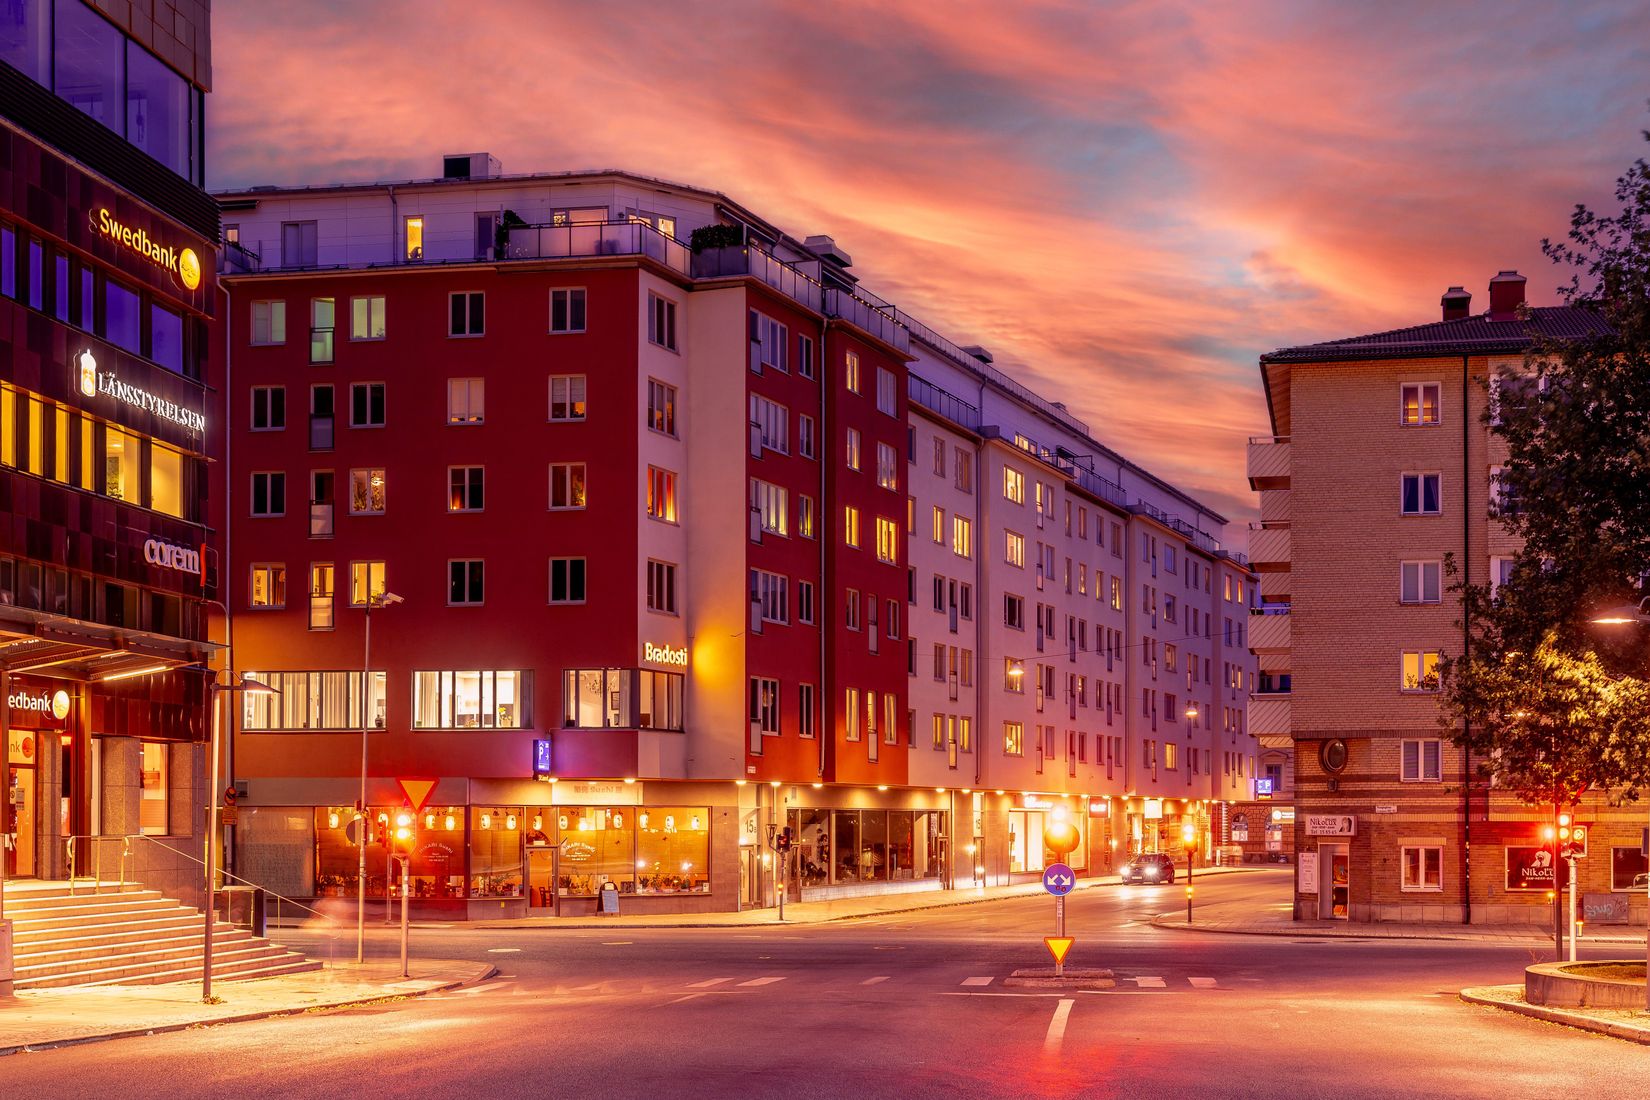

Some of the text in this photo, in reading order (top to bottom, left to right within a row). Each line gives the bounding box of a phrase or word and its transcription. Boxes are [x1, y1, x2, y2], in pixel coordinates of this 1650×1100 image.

[100, 208, 178, 273] Swedbank
[98, 372, 205, 432] LÄNSSTYRELSEN
[143, 539, 201, 575] corem
[645, 642, 688, 666] Bradosti
[8, 691, 52, 712] edbank
